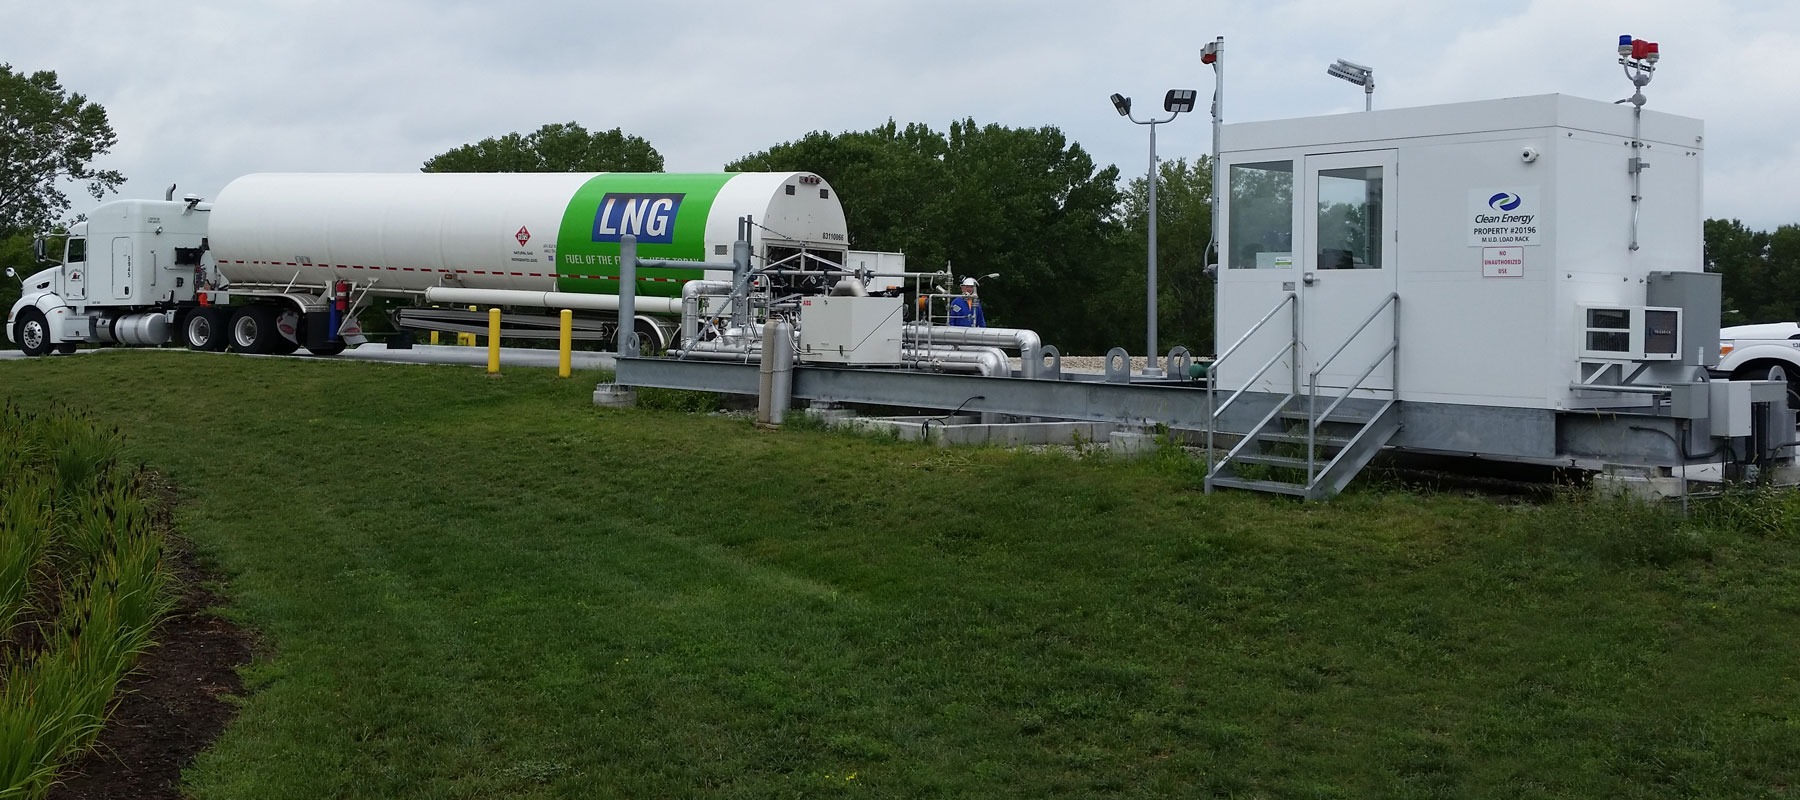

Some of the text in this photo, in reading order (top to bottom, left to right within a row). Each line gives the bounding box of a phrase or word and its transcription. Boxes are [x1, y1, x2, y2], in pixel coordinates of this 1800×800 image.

[599, 198, 673, 236] LNG
[1475, 214, 1534, 224] Clean Energy
[1474, 226, 1536, 235] PROPERTY #20196
[565, 254, 584, 264] FUEL
[585, 254, 596, 264] OF
[597, 255, 613, 265] THE
